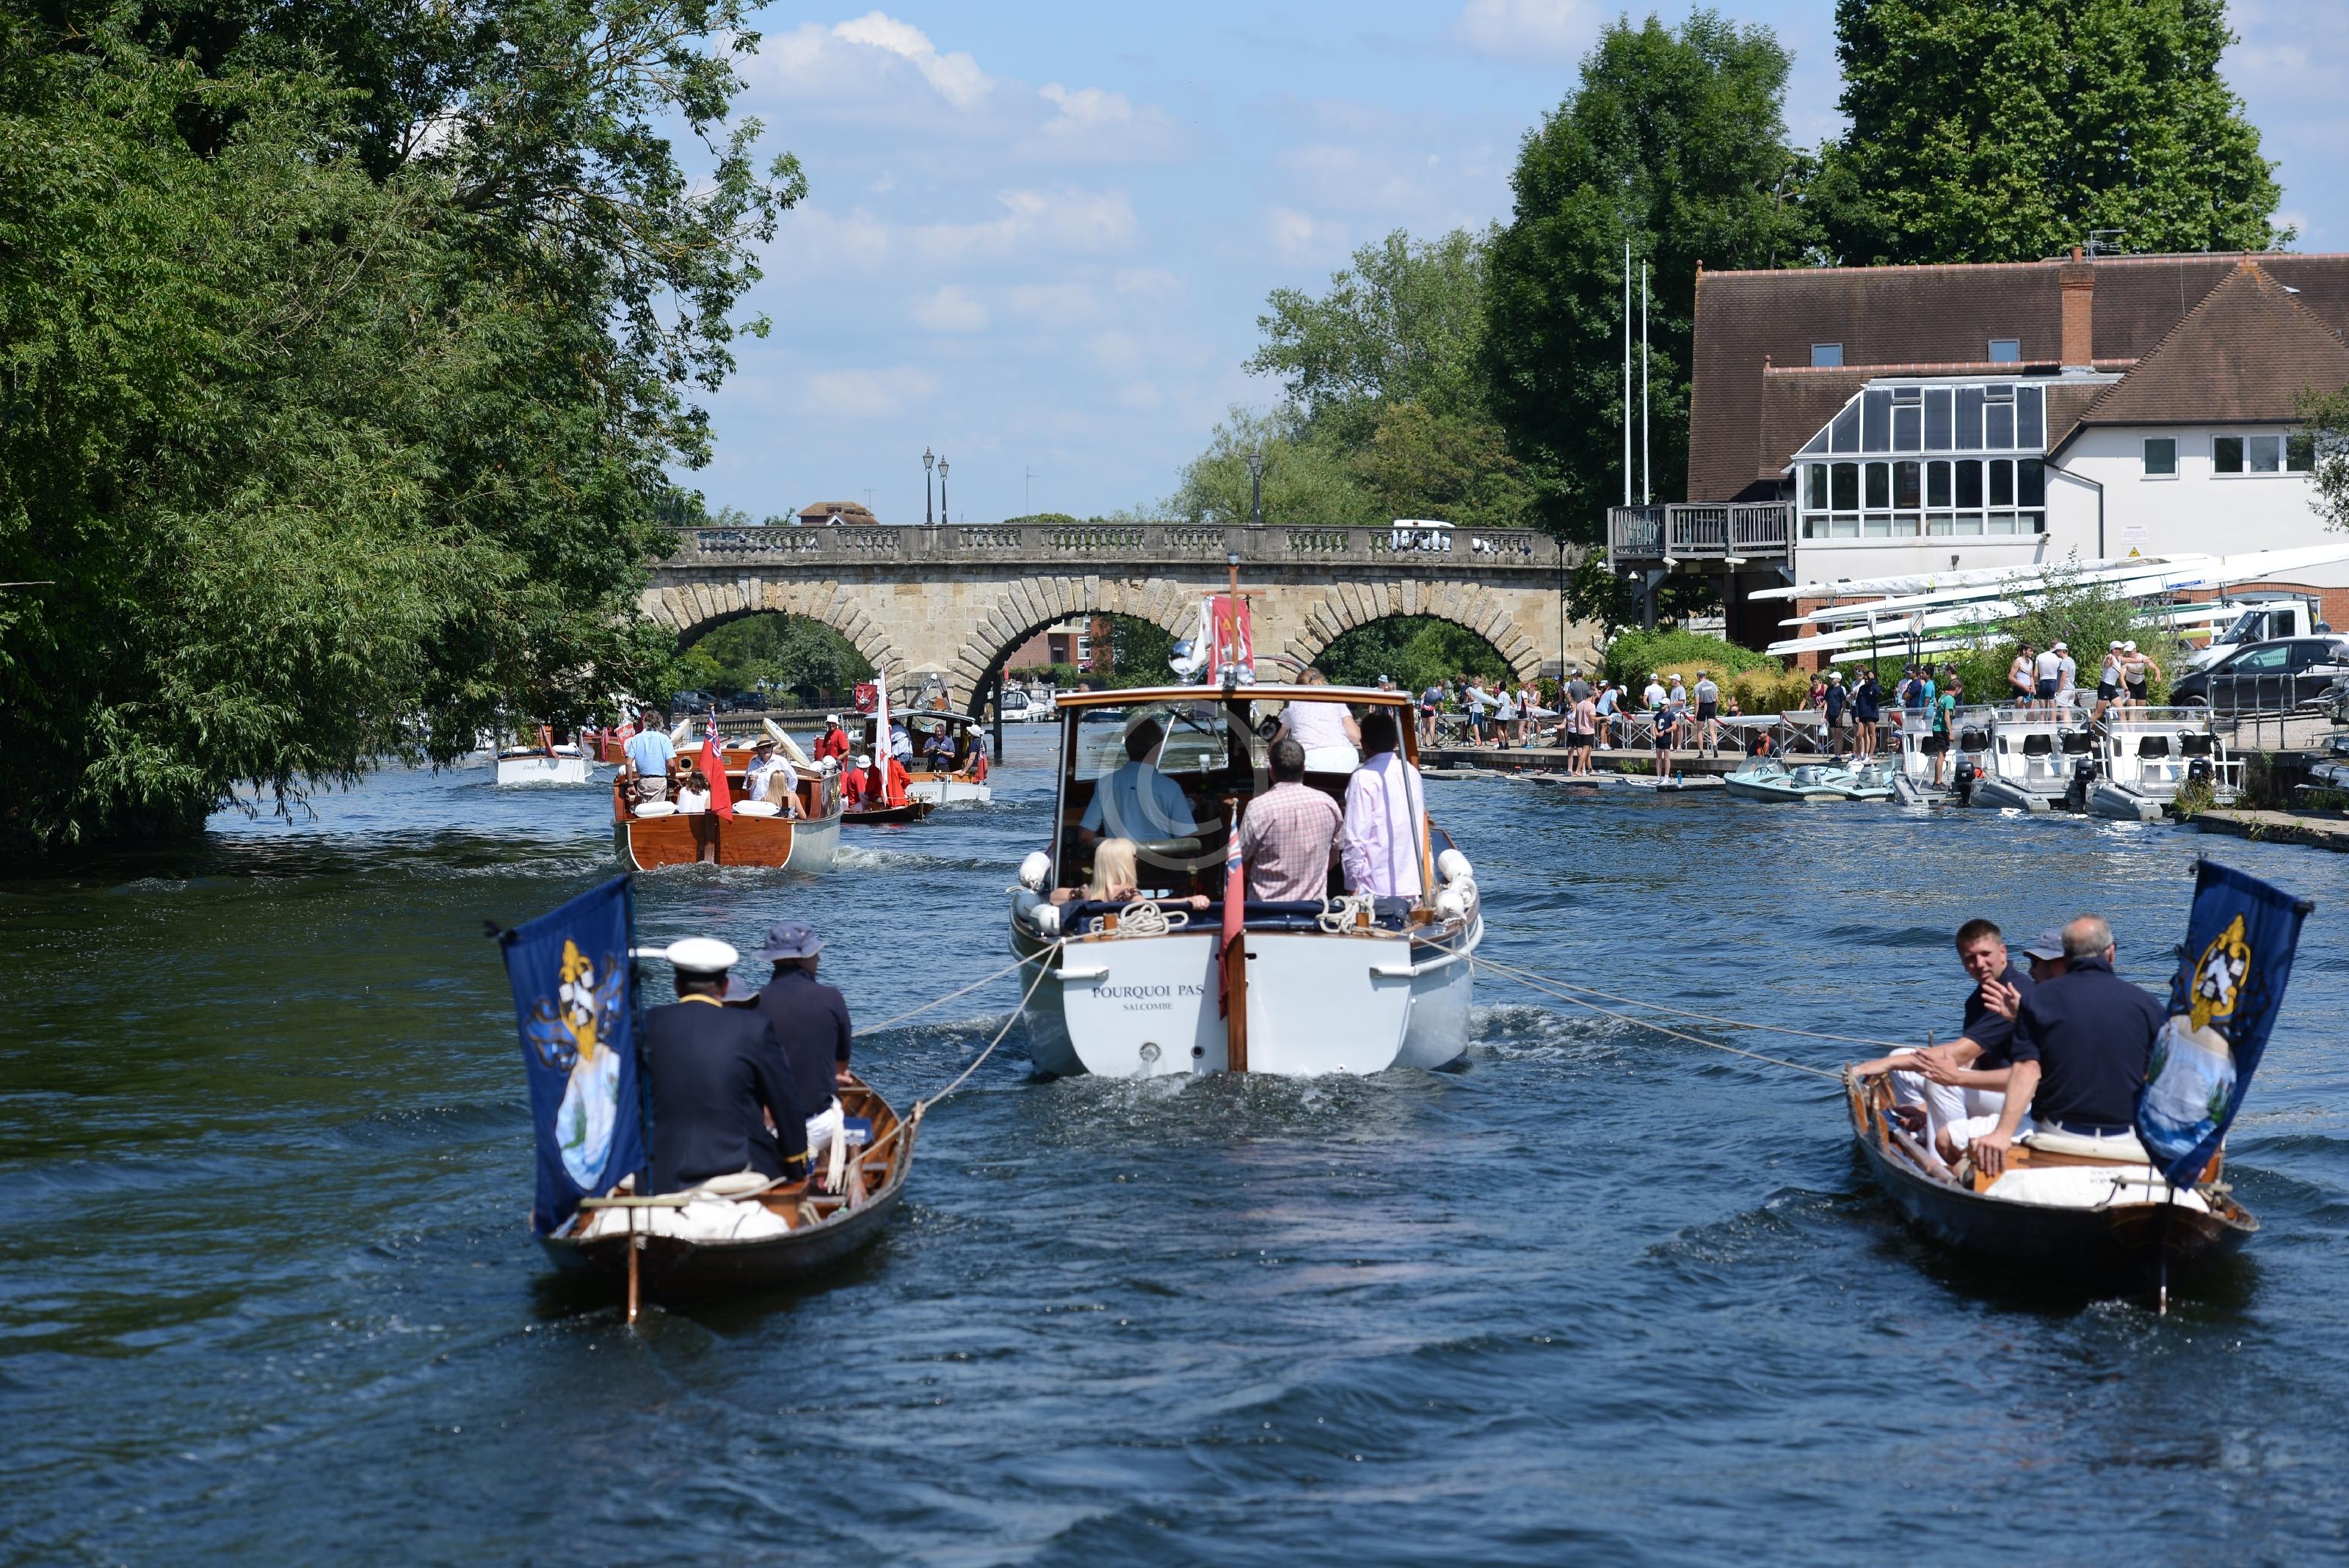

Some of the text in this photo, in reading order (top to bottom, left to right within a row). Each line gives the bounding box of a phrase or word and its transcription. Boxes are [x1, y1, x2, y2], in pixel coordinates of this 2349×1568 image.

[1092, 984, 1205, 999] POURQUOI PAS
[1123, 1003, 1173, 1011] SALCOMBE
